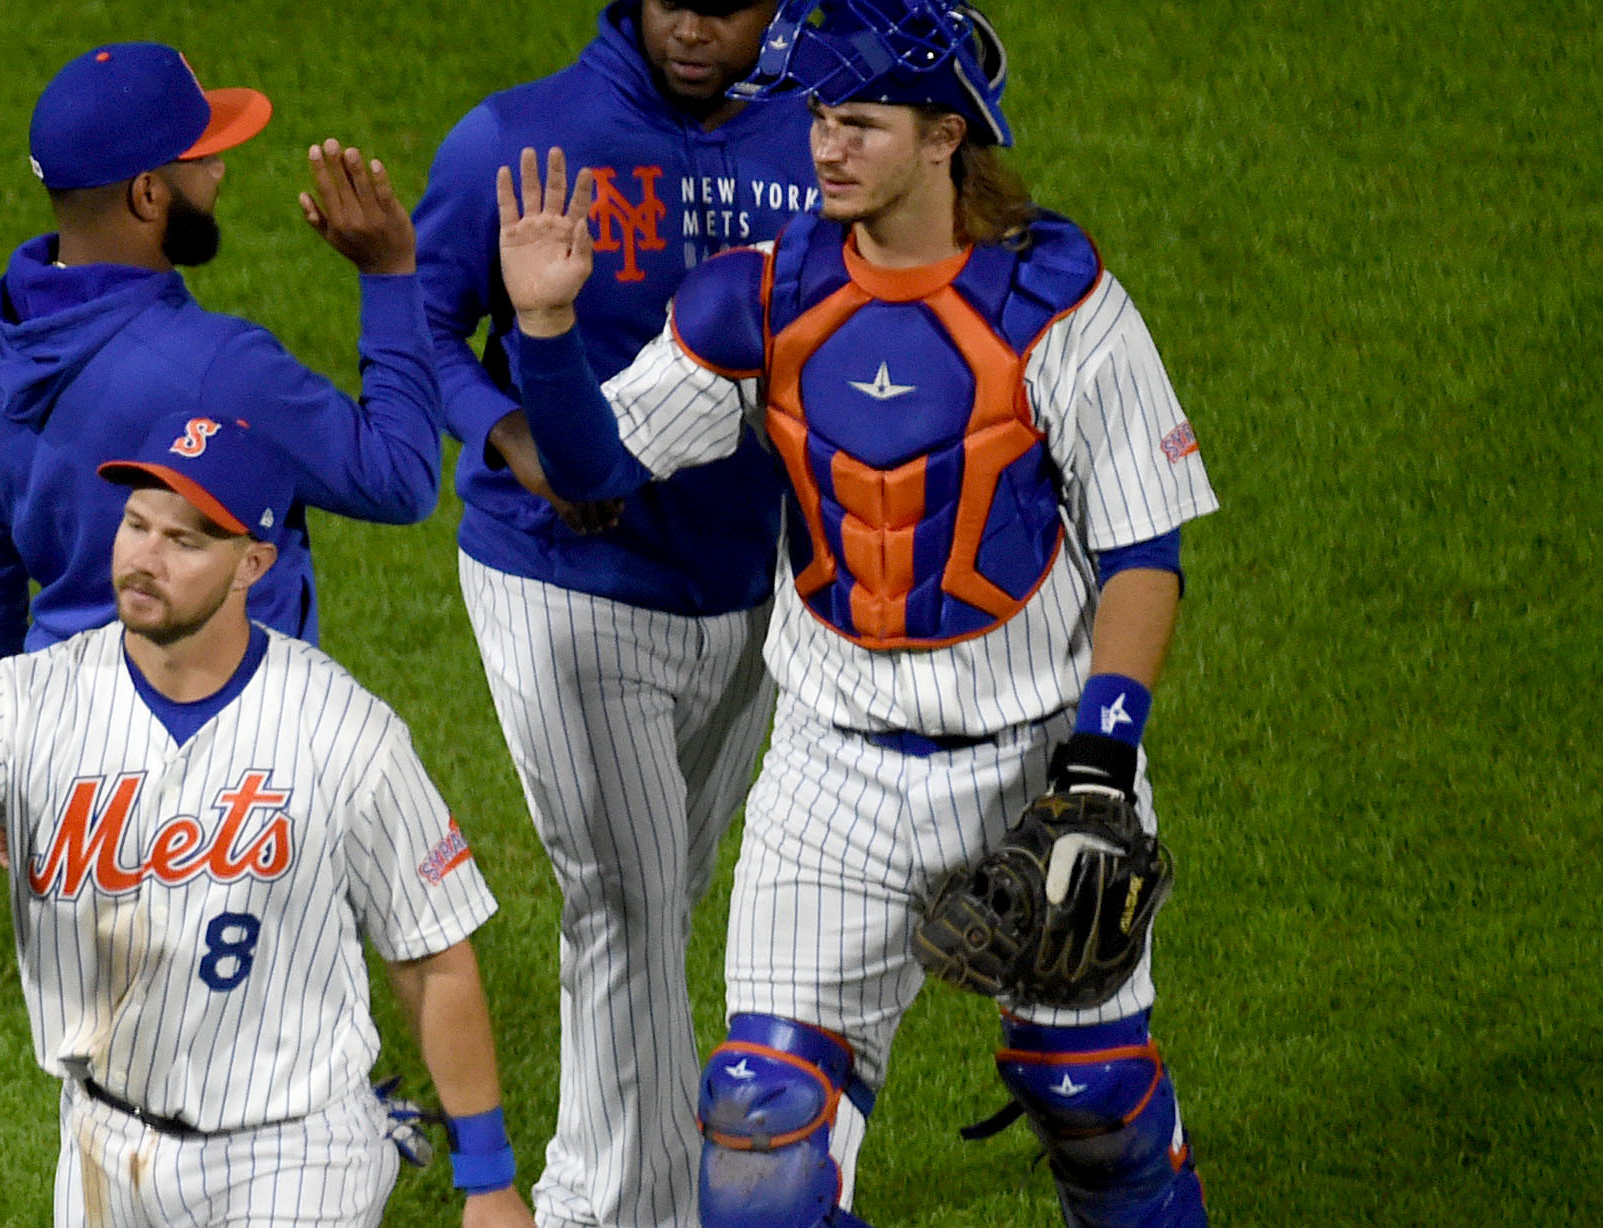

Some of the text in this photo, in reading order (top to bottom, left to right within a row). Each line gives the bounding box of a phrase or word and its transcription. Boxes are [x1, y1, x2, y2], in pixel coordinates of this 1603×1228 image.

[589, 166, 666, 281] NY
[681, 176, 819, 213] NEW YORK
[682, 209, 751, 239] METS
[169, 416, 222, 458] S
[28, 769, 295, 903] Mets
[198, 911, 261, 993] 8
